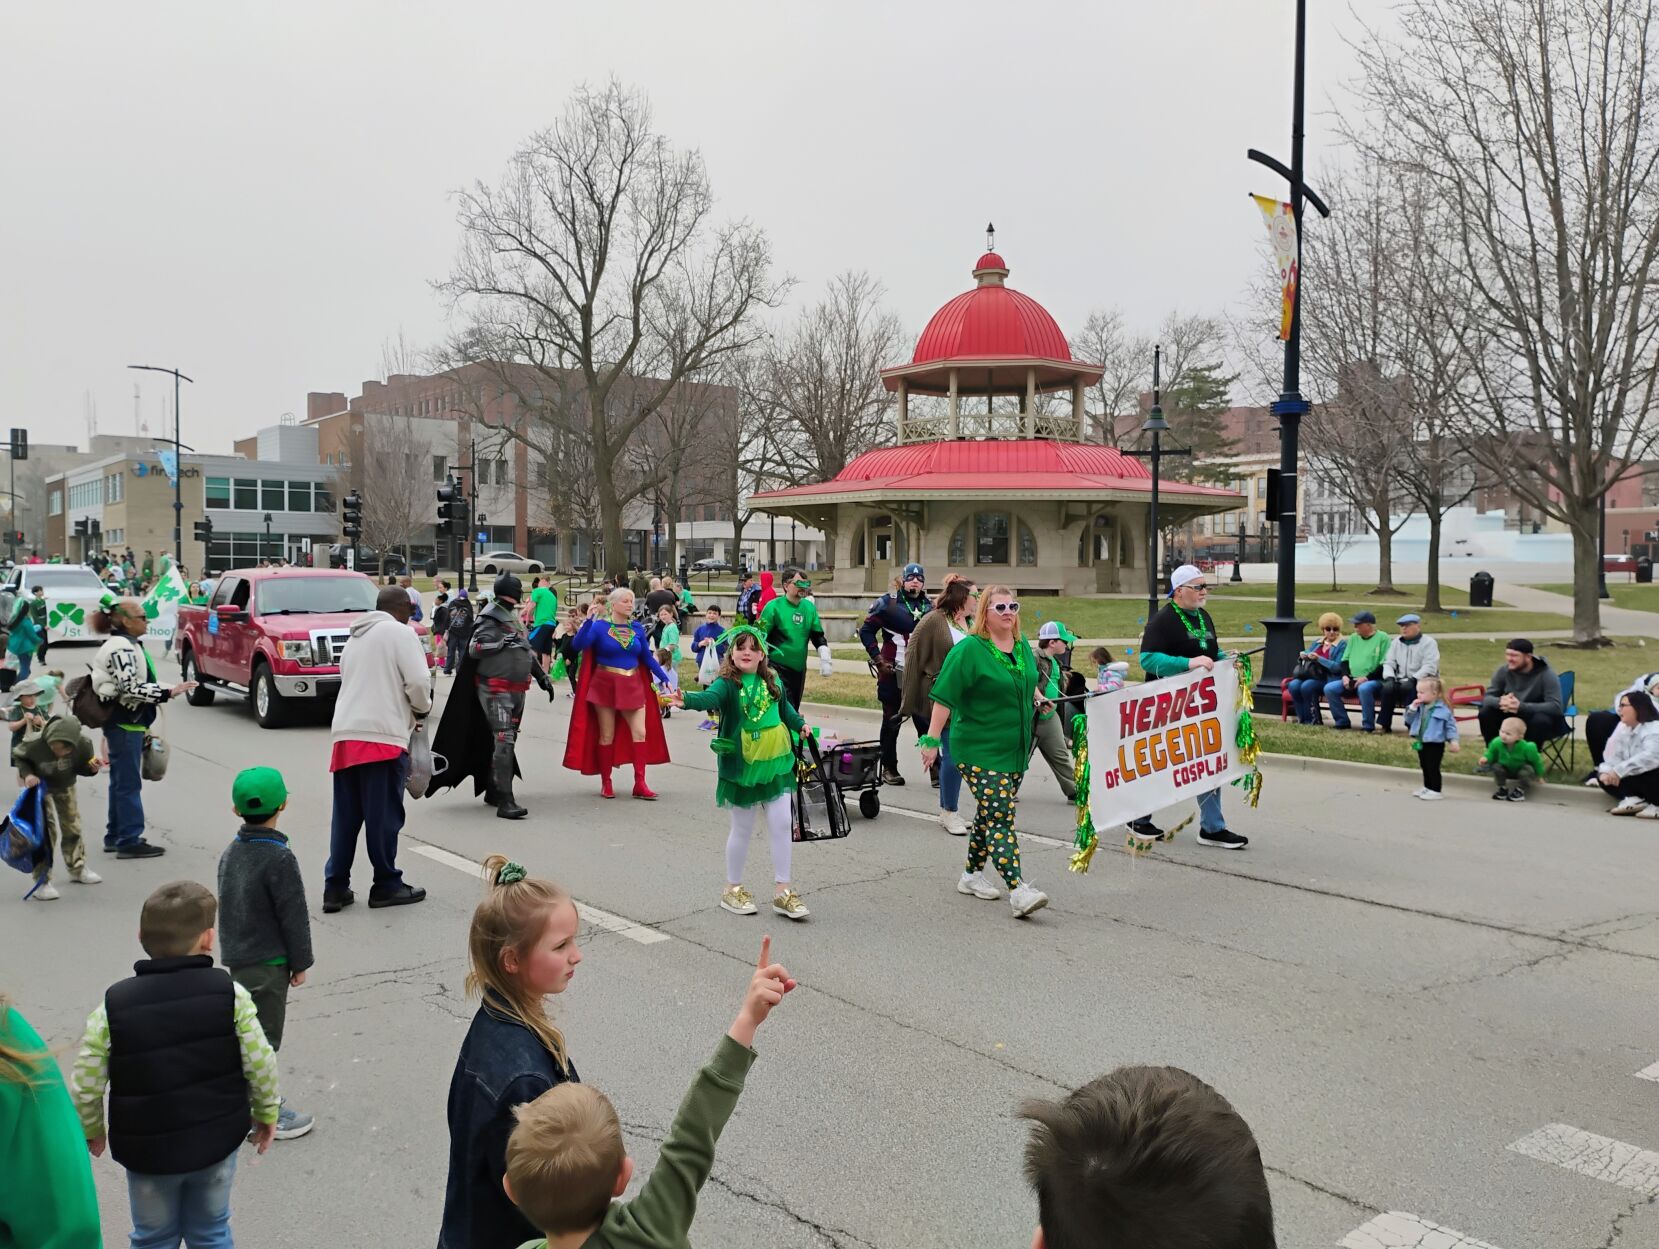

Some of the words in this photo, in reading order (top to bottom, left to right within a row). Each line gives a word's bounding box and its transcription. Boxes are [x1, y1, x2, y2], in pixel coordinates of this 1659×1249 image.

[1119, 676, 1218, 740] HEROES
[1105, 766, 1120, 789] OF
[1118, 717, 1222, 783] LEGEND
[1172, 752, 1228, 788] COSPLAY
